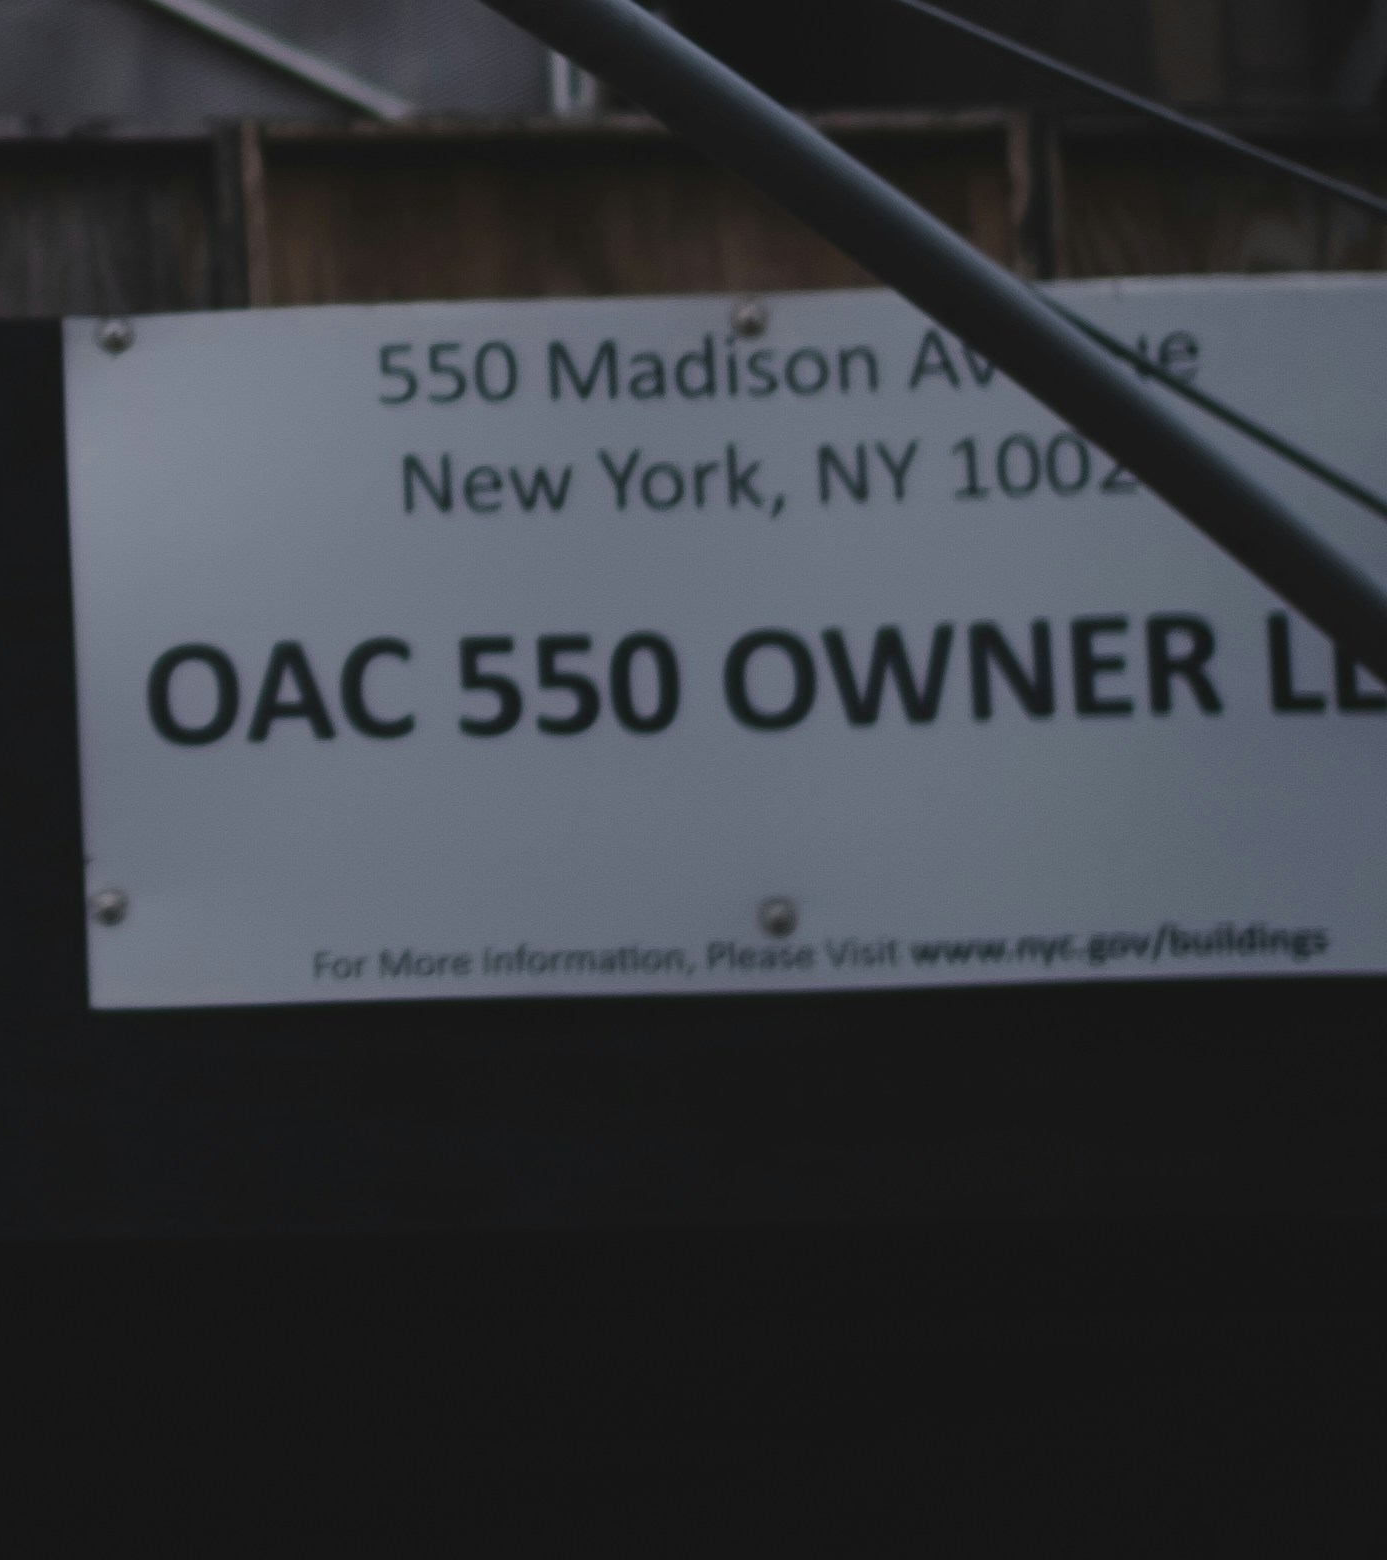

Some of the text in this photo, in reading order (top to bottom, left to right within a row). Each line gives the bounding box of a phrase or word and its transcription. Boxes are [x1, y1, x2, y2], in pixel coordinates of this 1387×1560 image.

[378, 326, 1200, 406] 550 Madison Ave
[402, 453, 573, 515] New
[597, 443, 786, 519] York,
[817, 440, 919, 505] NY
[147, 637, 415, 747] OAC
[459, 631, 681, 738] 550
[723, 613, 1223, 733] OWNER
[312, 922, 1330, 981] For More Information, Please Visit www.nyc.gov/buildings
